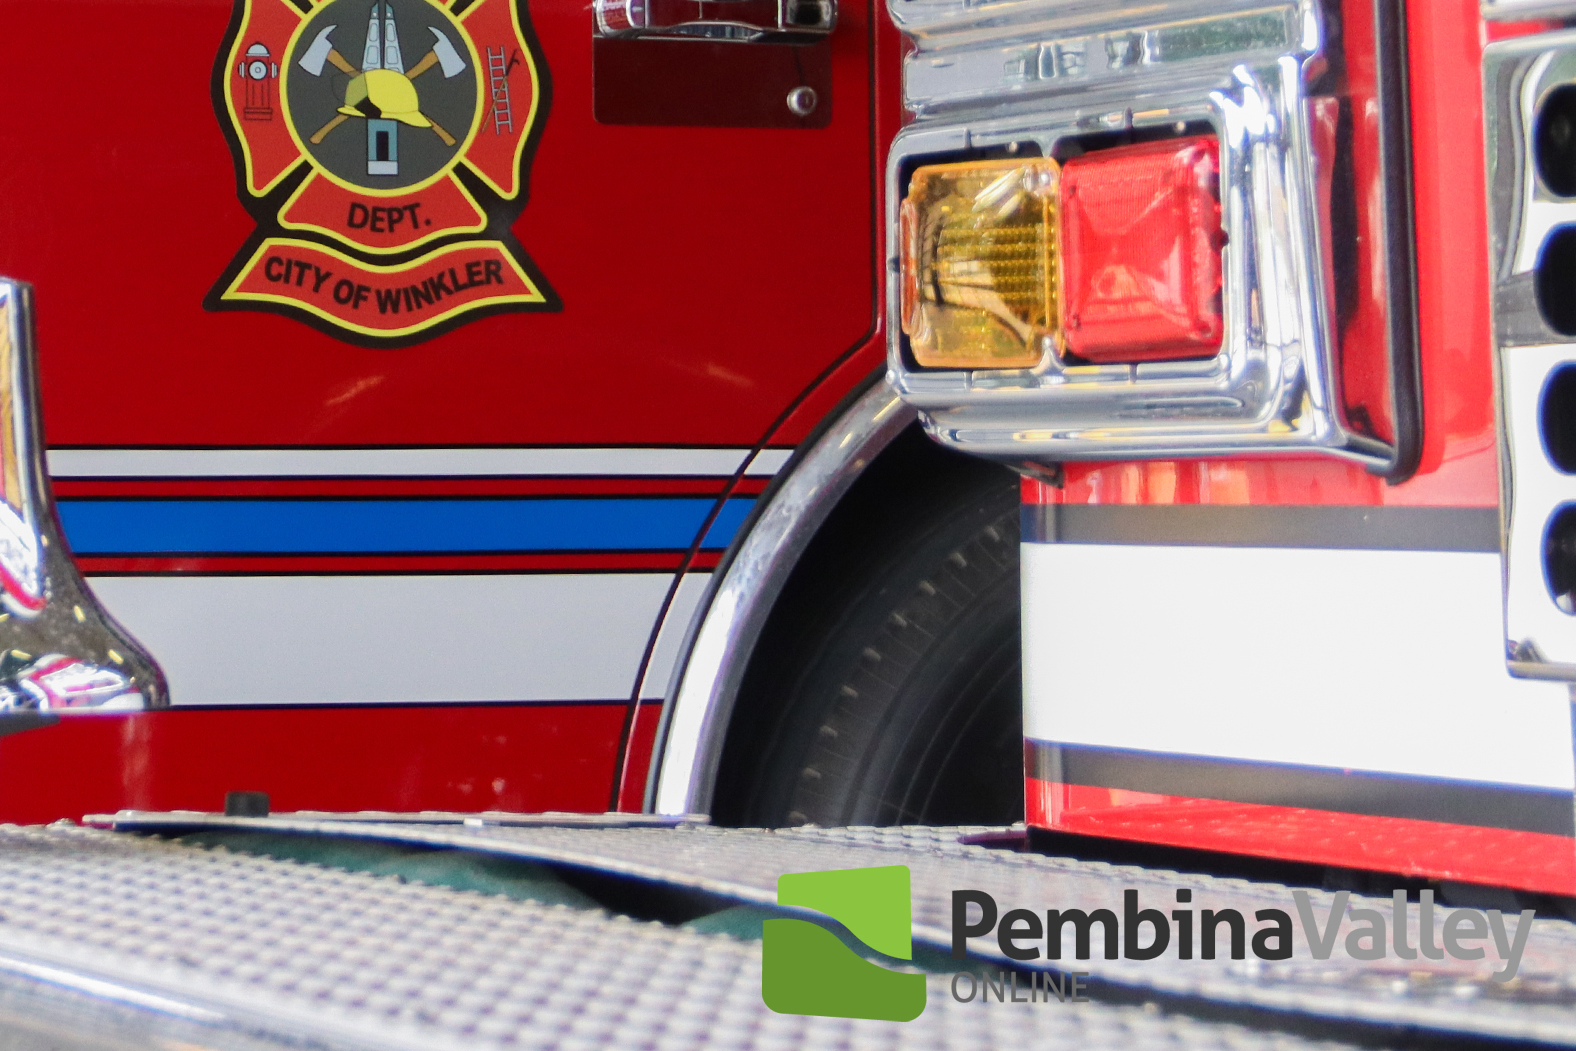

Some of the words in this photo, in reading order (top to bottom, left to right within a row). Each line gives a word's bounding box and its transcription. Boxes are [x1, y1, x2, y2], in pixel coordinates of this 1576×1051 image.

[346, 201, 433, 233] DEPT.
[263, 256, 333, 294] CITY
[332, 275, 372, 306] OF
[375, 259, 504, 315] WINKLER
